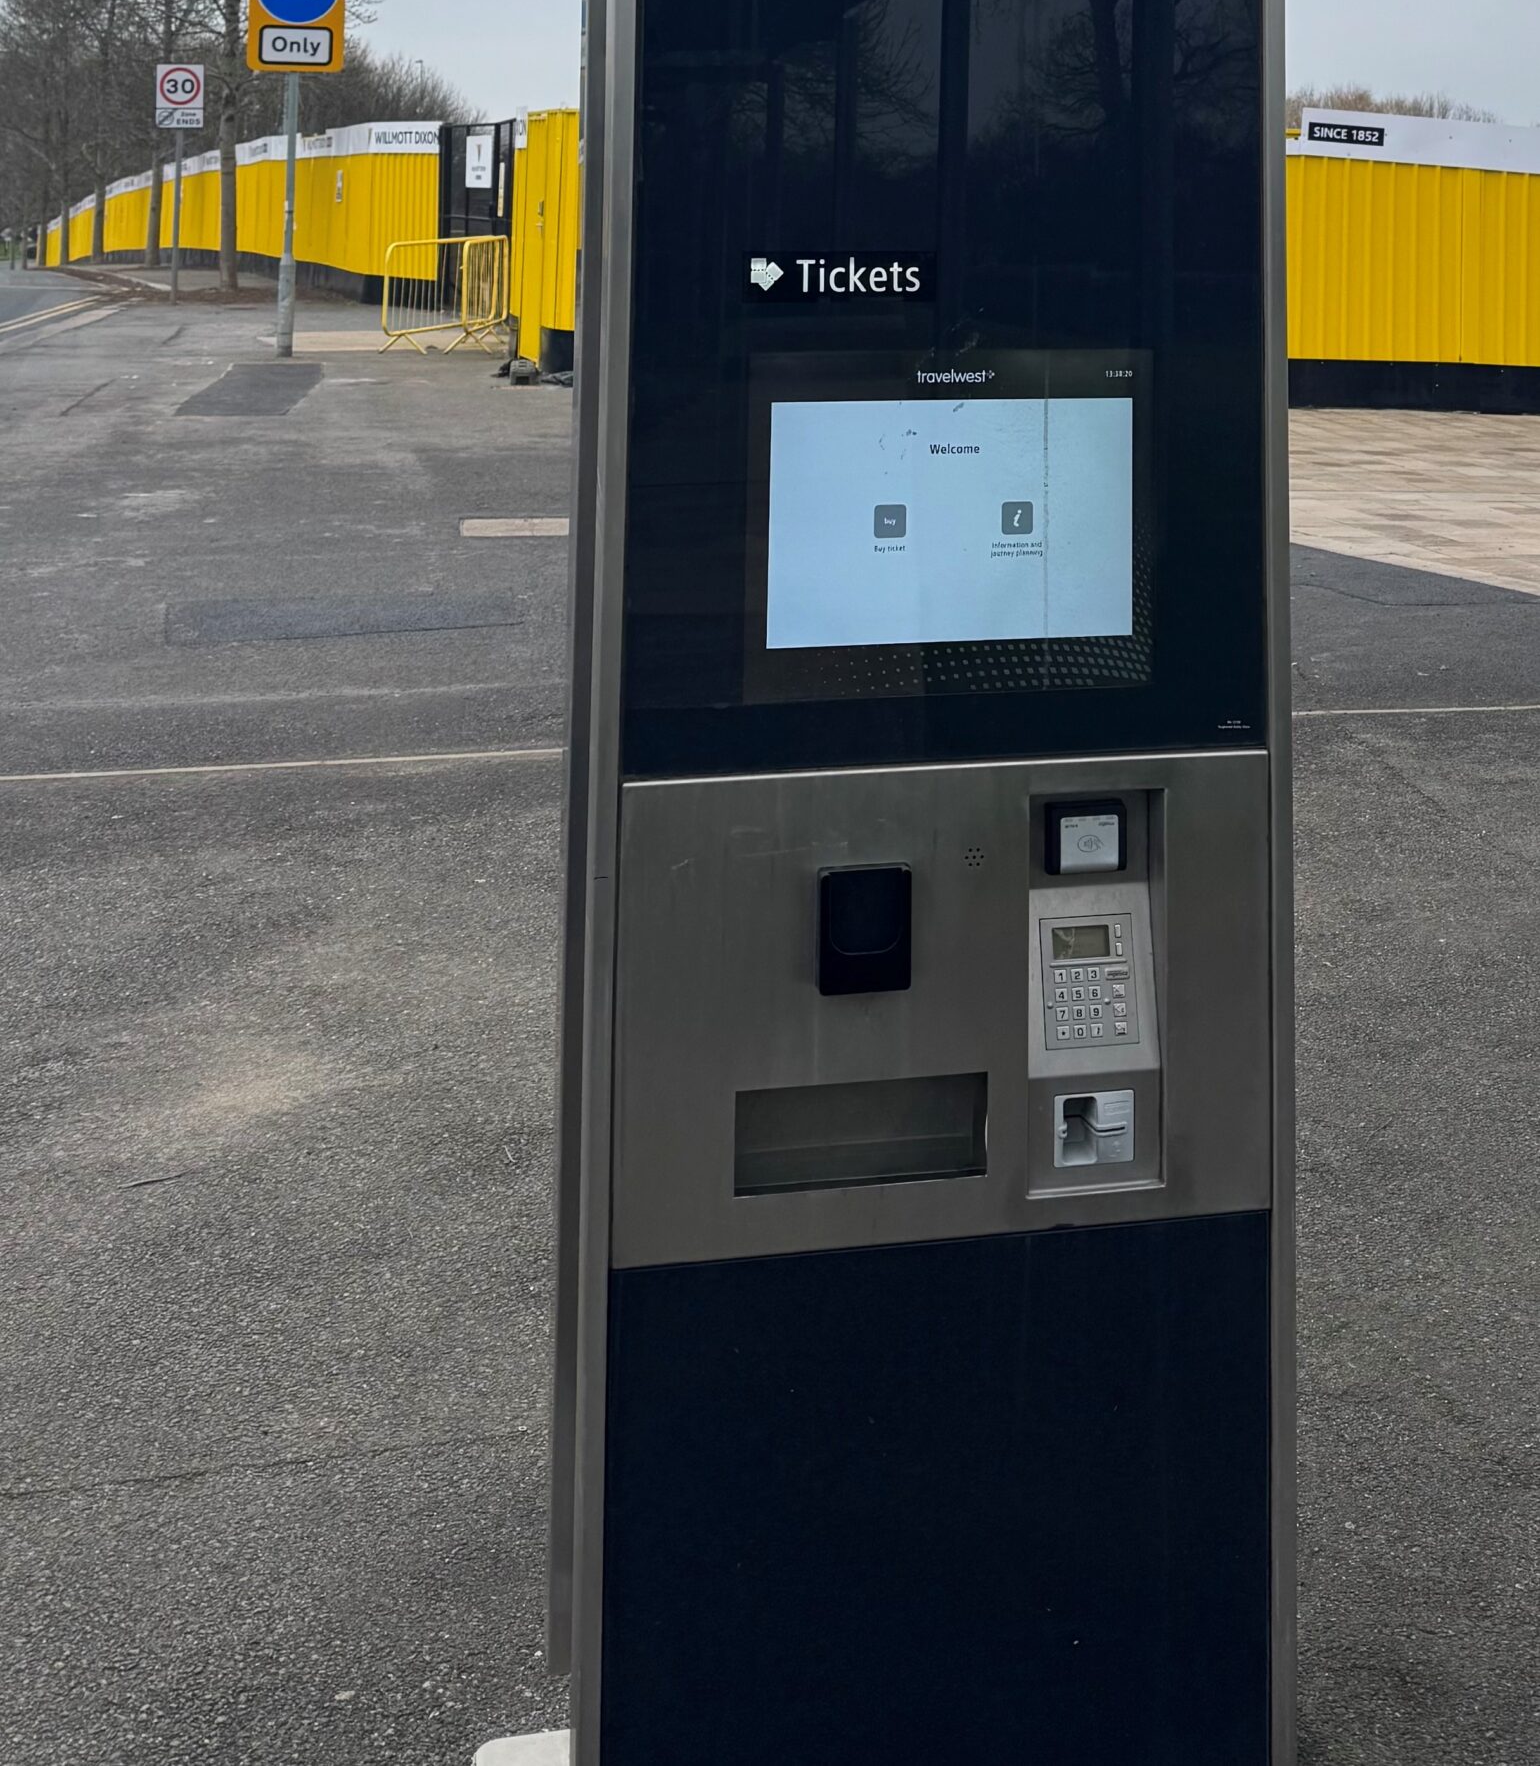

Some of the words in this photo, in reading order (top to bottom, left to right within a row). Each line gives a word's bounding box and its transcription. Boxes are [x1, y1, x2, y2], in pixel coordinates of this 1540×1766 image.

[271, 36, 321, 56] Only
[166, 78, 195, 95] 30
[374, 130, 413, 145] WILLMOTT
[1313, 126, 1348, 140] SINCE
[1351, 129, 1379, 143] 1852
[795, 256, 921, 293] Tickets
[917, 368, 986, 384] travelwest
[929, 443, 980, 455] Welcome
[874, 545, 886, 554] Buy
[991, 541, 1029, 549] Information
[1058, 972, 1064, 981] 1
[1074, 970, 1081, 981] 2
[1091, 970, 1097, 980] 3
[1058, 991, 1065, 1000] 4
[1075, 989, 1082, 999] 5
[1092, 989, 1098, 998] 6
[1059, 1009, 1066, 1019] 7
[1076, 1008, 1083, 1018] 8
[1093, 1008, 1099, 1017] 9
[1077, 1028, 1083, 1037] 0
